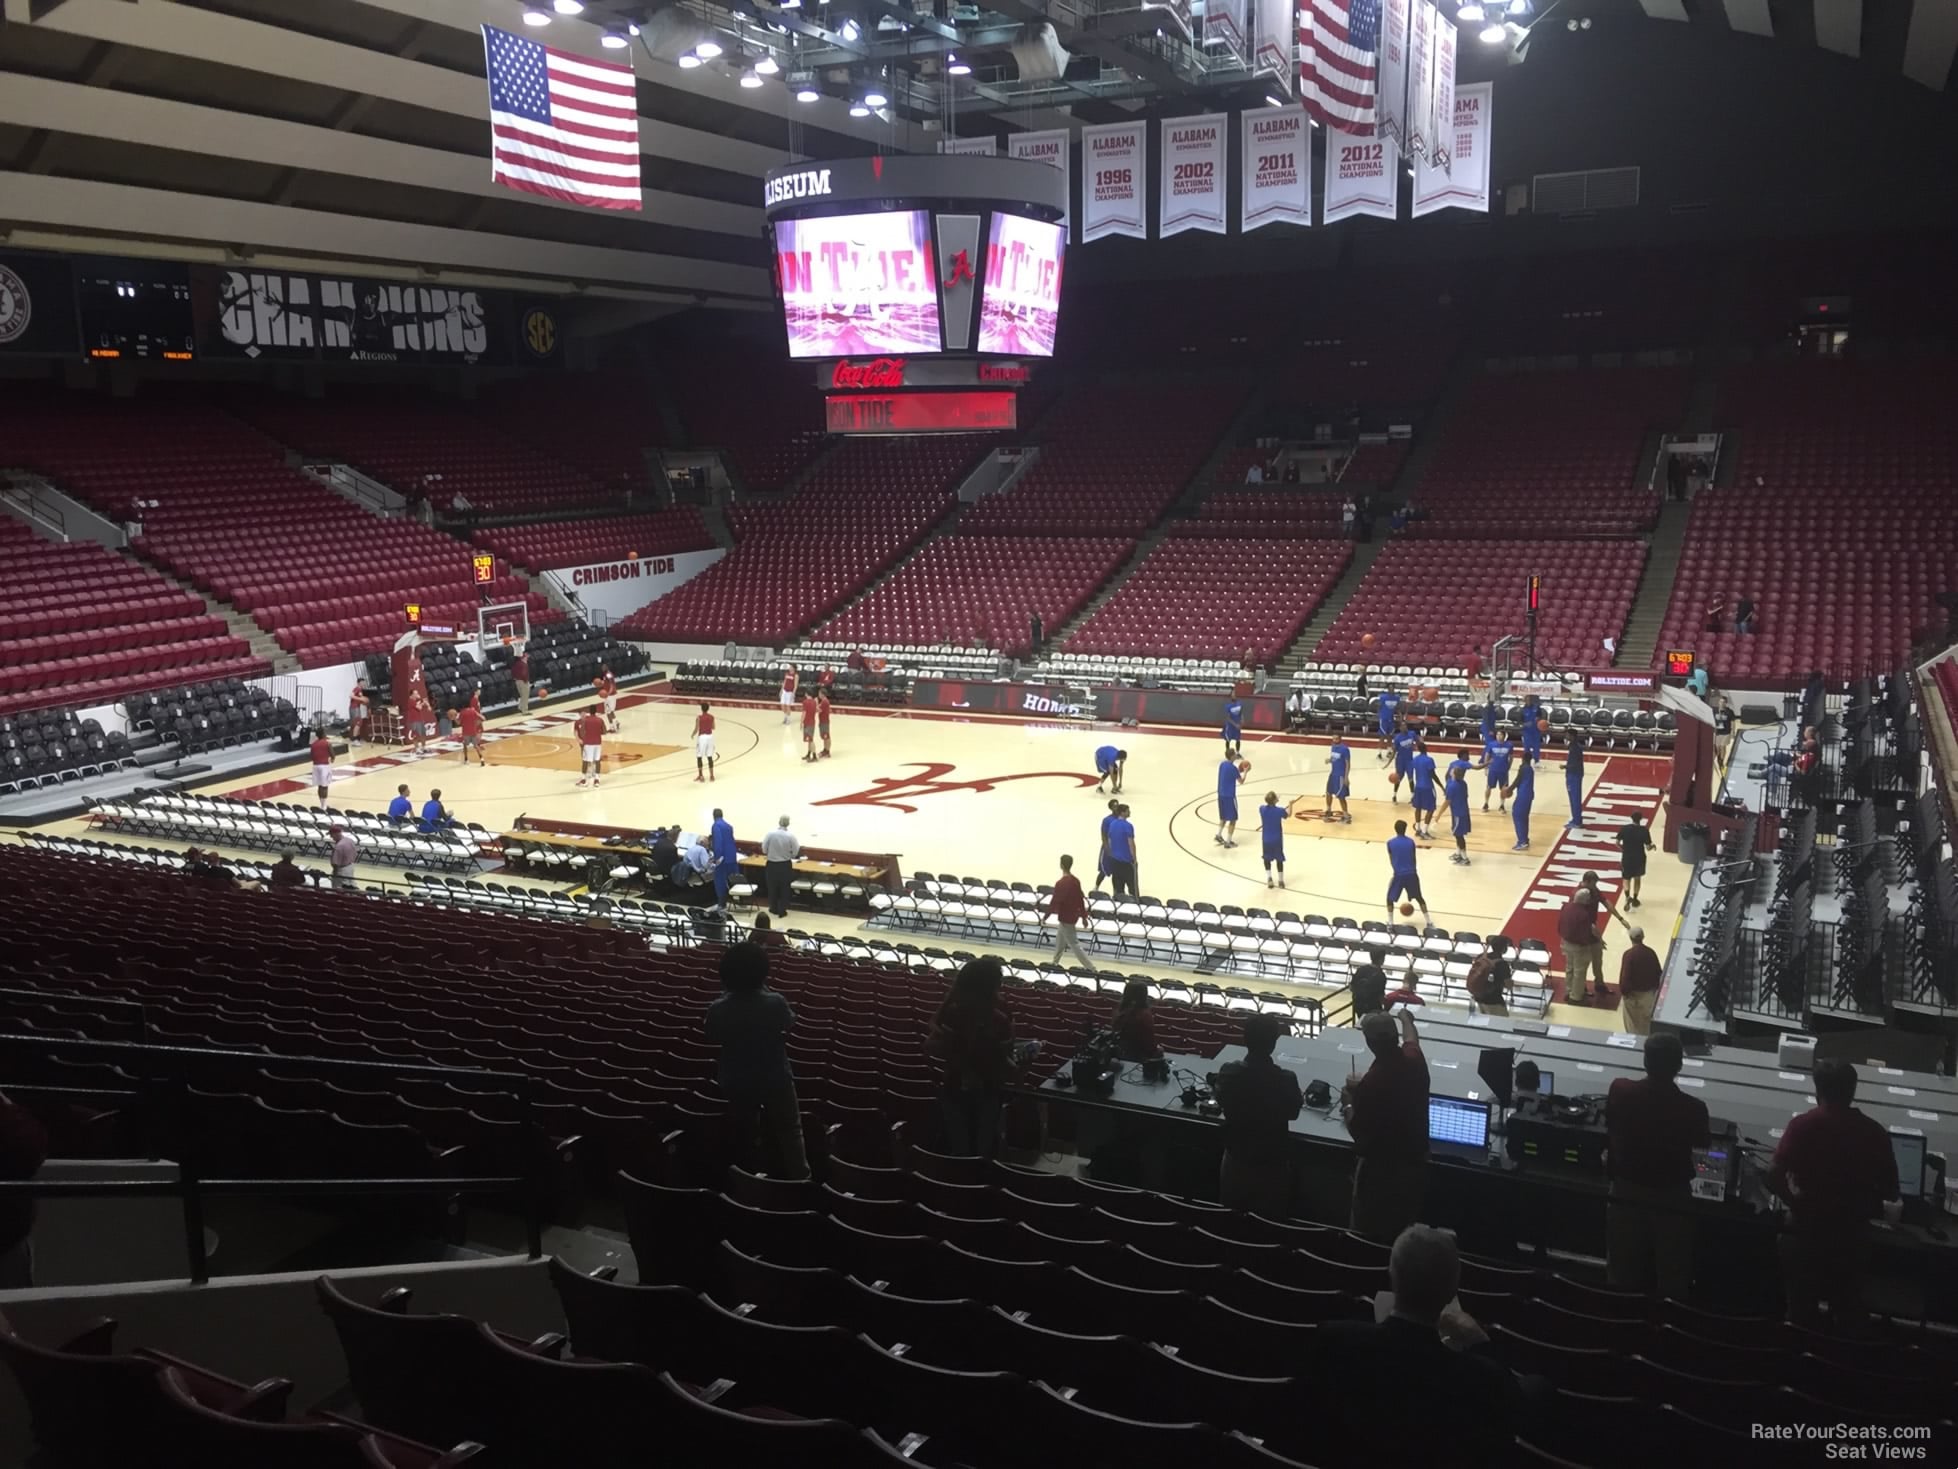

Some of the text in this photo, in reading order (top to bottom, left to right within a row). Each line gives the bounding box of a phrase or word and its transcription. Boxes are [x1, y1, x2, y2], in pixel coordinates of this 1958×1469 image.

[1253, 118, 1300, 135] ALABAMA
[1092, 135, 1136, 150] ALABAMA
[1171, 127, 1216, 143] ALABAMA
[1018, 143, 1060, 158] ALABAMA
[1341, 144, 1383, 163] 2012
[1258, 153, 1294, 171] 2011
[1339, 161, 1383, 171] NATIONAL
[1096, 169, 1132, 186] 1996
[1174, 162, 1213, 179] 2002
[1256, 169, 1298, 180] NATIONAL
[1339, 169, 1383, 179] CHAMPIONS
[1095, 184, 1133, 195] NATIONAL
[1173, 178, 1213, 188] NATIONAL
[1255, 178, 1297, 189] CHAMPIONS
[1095, 192, 1133, 202] CHAMPIONS
[1173, 186, 1213, 196] CHAMPIONS
[219, 271, 488, 353] CHAMIONS
[526, 310, 557, 352] SEC
[359, 350, 397, 361] REGIONS
[832, 358, 906, 388] Coca-Cola
[477, 566, 490, 581] 30
[572, 557, 676, 586] CRIMSON TIDE
[1669, 653, 1692, 662] 67:03
[1671, 662, 1689, 673] 30
